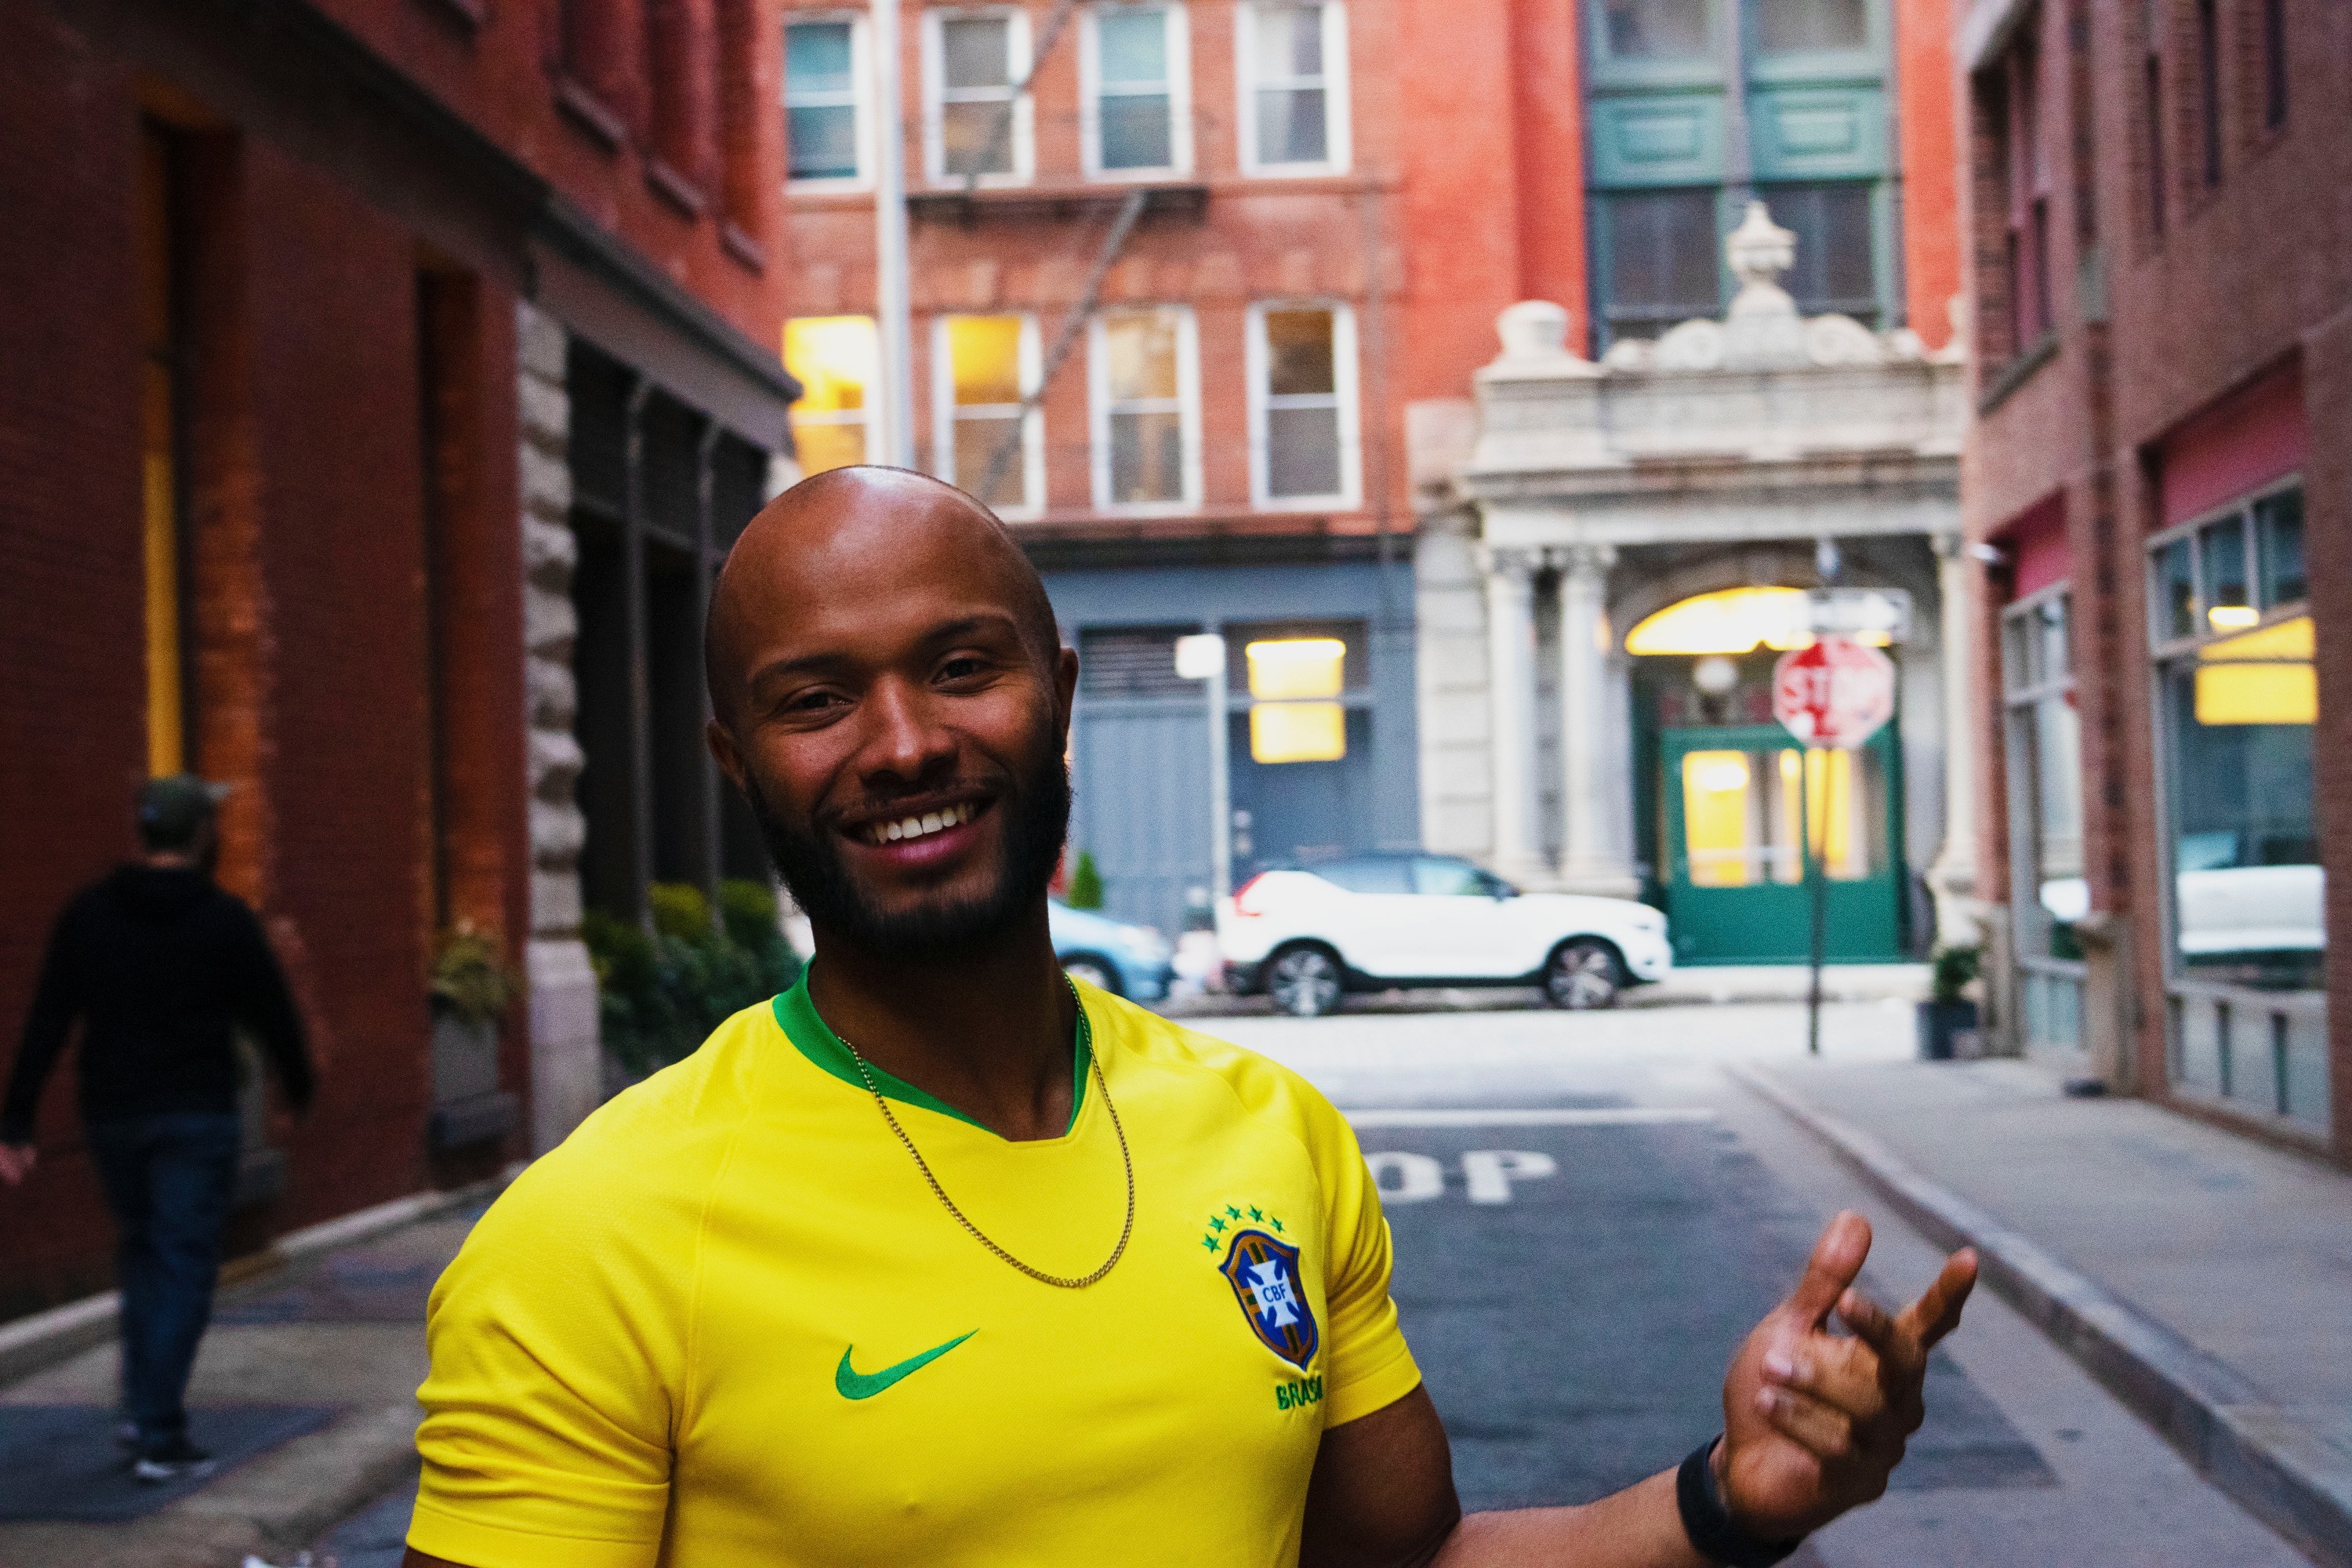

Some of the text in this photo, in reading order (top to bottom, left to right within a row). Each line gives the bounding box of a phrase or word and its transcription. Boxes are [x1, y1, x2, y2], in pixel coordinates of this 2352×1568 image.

[1364, 1150, 1556, 1204] OP
[1262, 1282, 1286, 1302] CBF
[1276, 1375, 1323, 1410] BRASI
